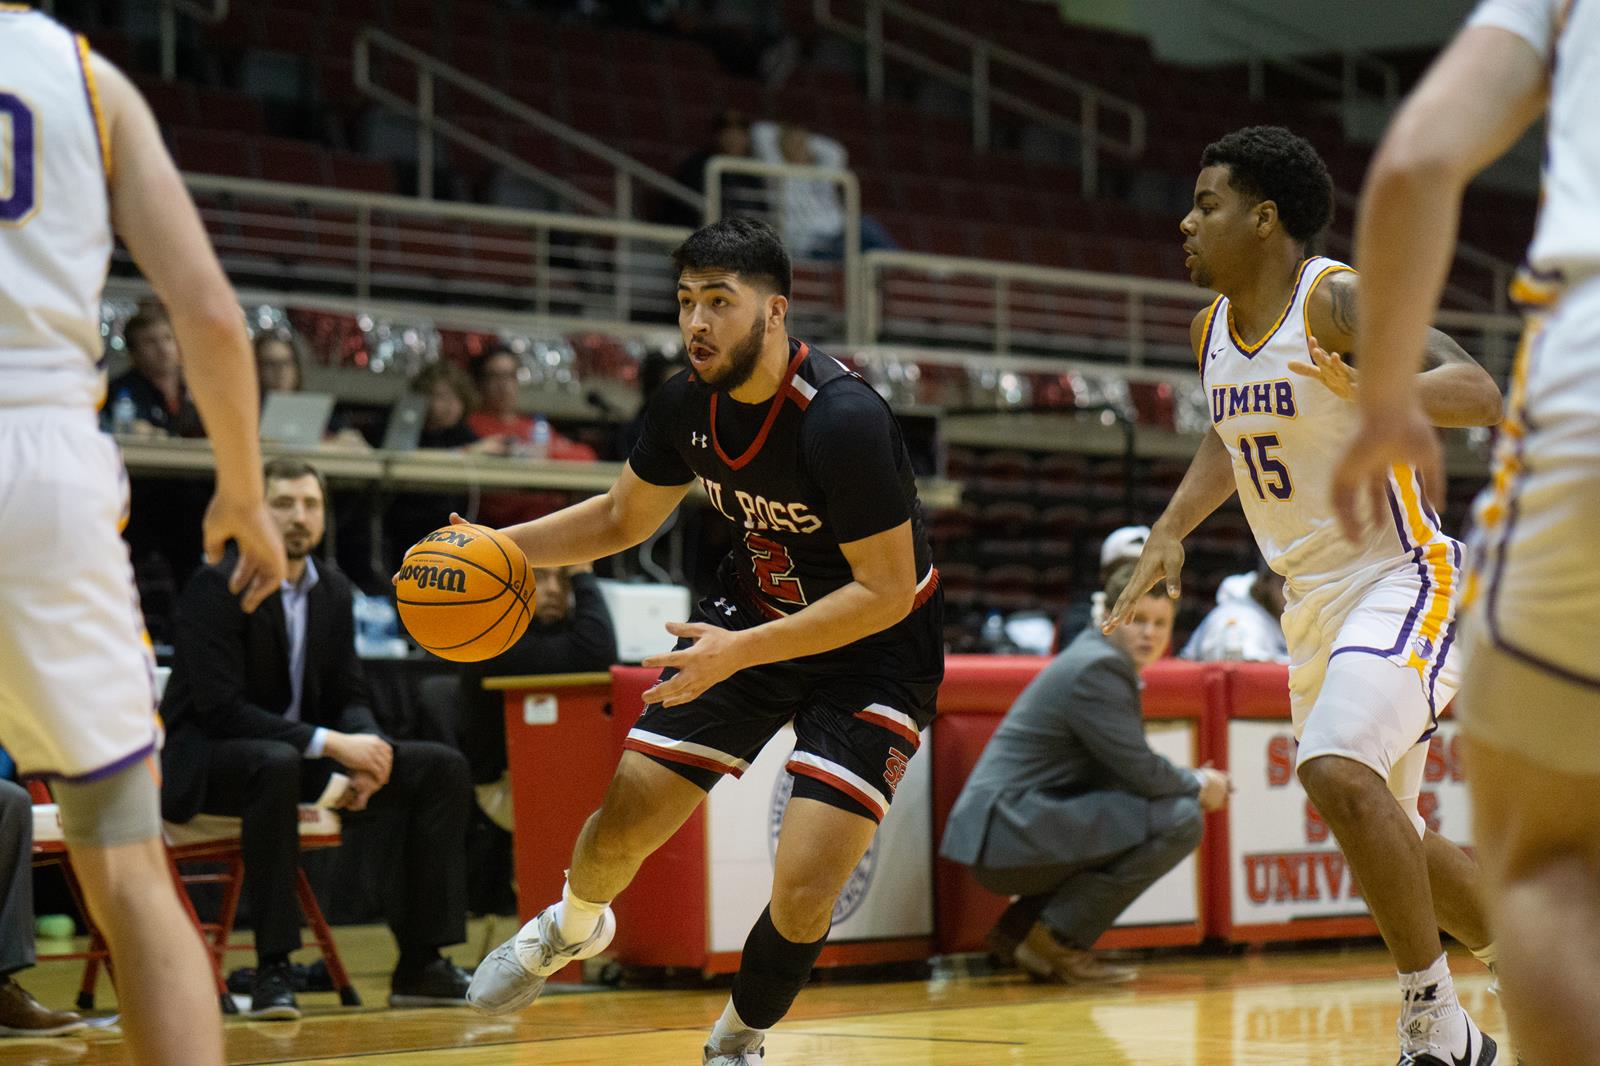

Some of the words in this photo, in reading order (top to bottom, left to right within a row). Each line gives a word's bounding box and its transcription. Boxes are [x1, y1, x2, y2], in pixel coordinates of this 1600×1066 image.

[1211, 377, 1299, 428] UMHB
[1238, 432, 1296, 503] 15
[734, 490, 823, 534] ROSS
[743, 530, 808, 606] 2
